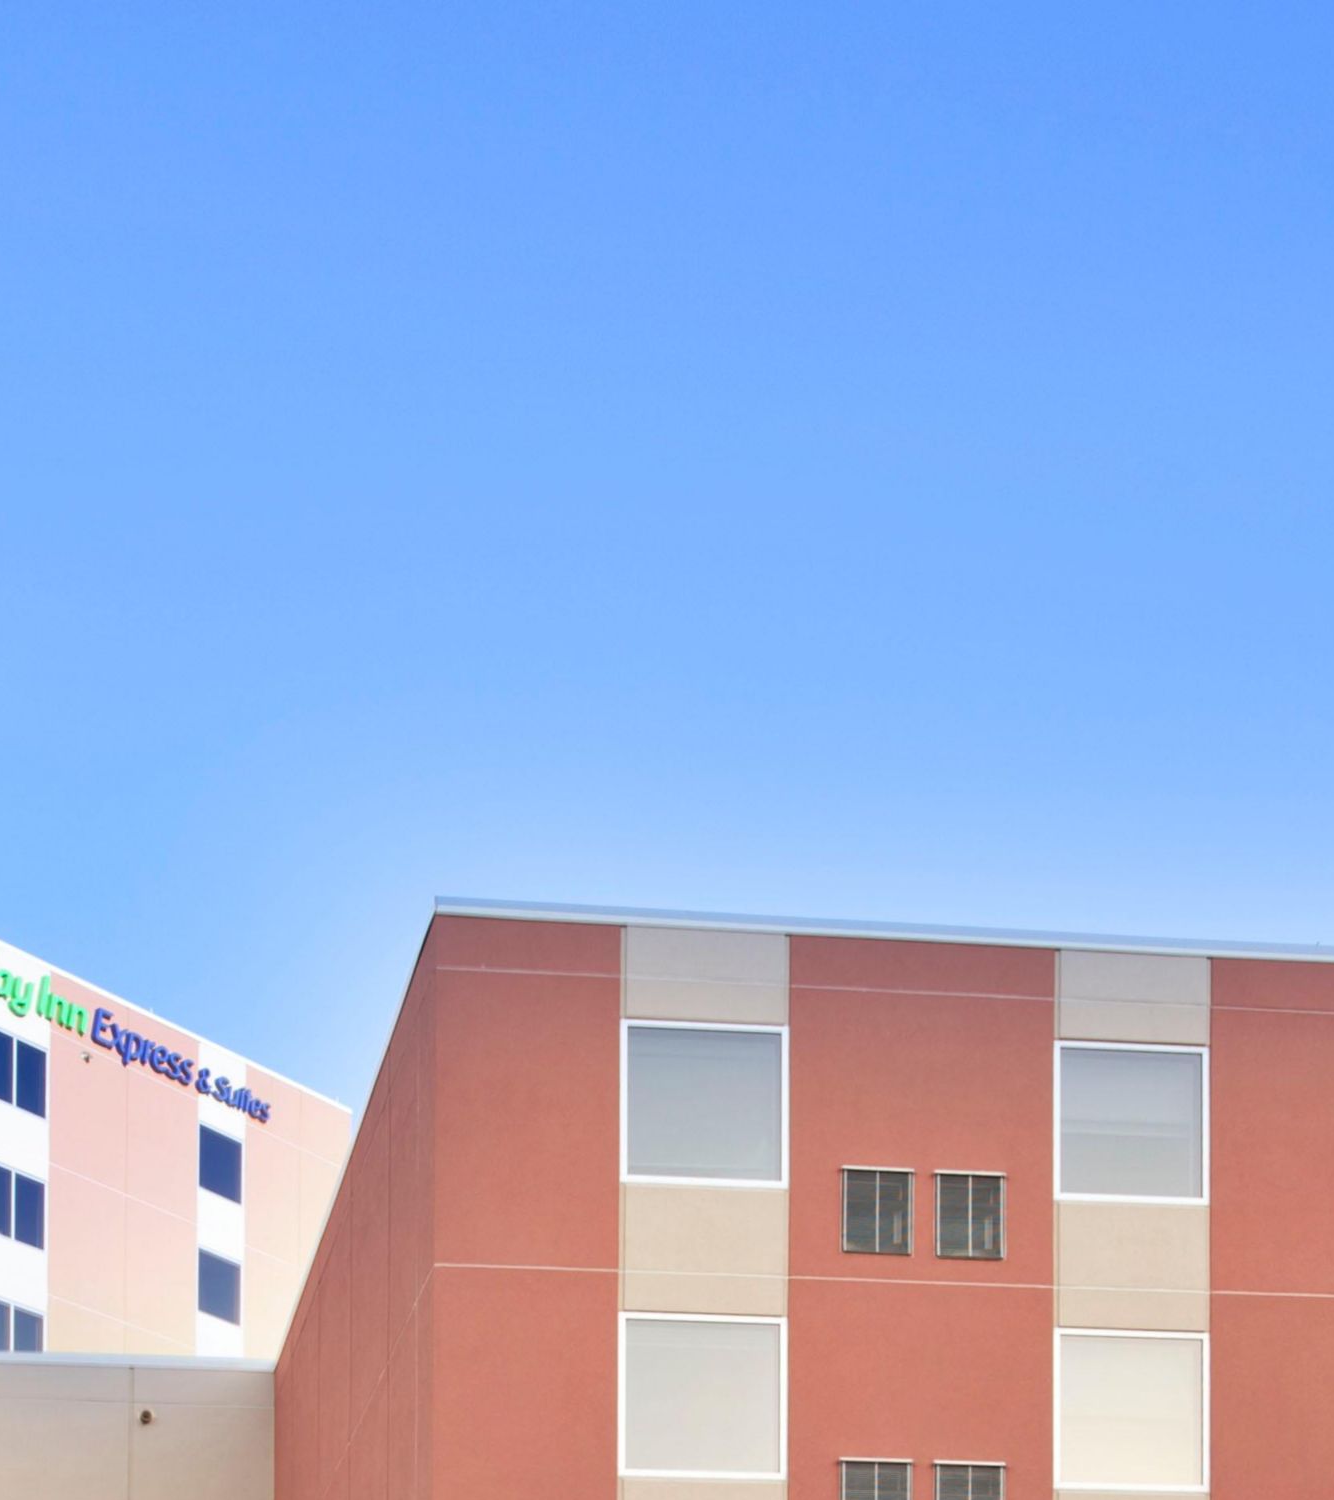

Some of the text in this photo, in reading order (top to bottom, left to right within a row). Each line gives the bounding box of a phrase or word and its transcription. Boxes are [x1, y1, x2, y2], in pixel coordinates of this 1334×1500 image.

[36, 974, 89, 1037] Inn
[91, 1007, 195, 1086] Express
[195, 1067, 212, 1096] &
[212, 1076, 271, 1124] Suites
